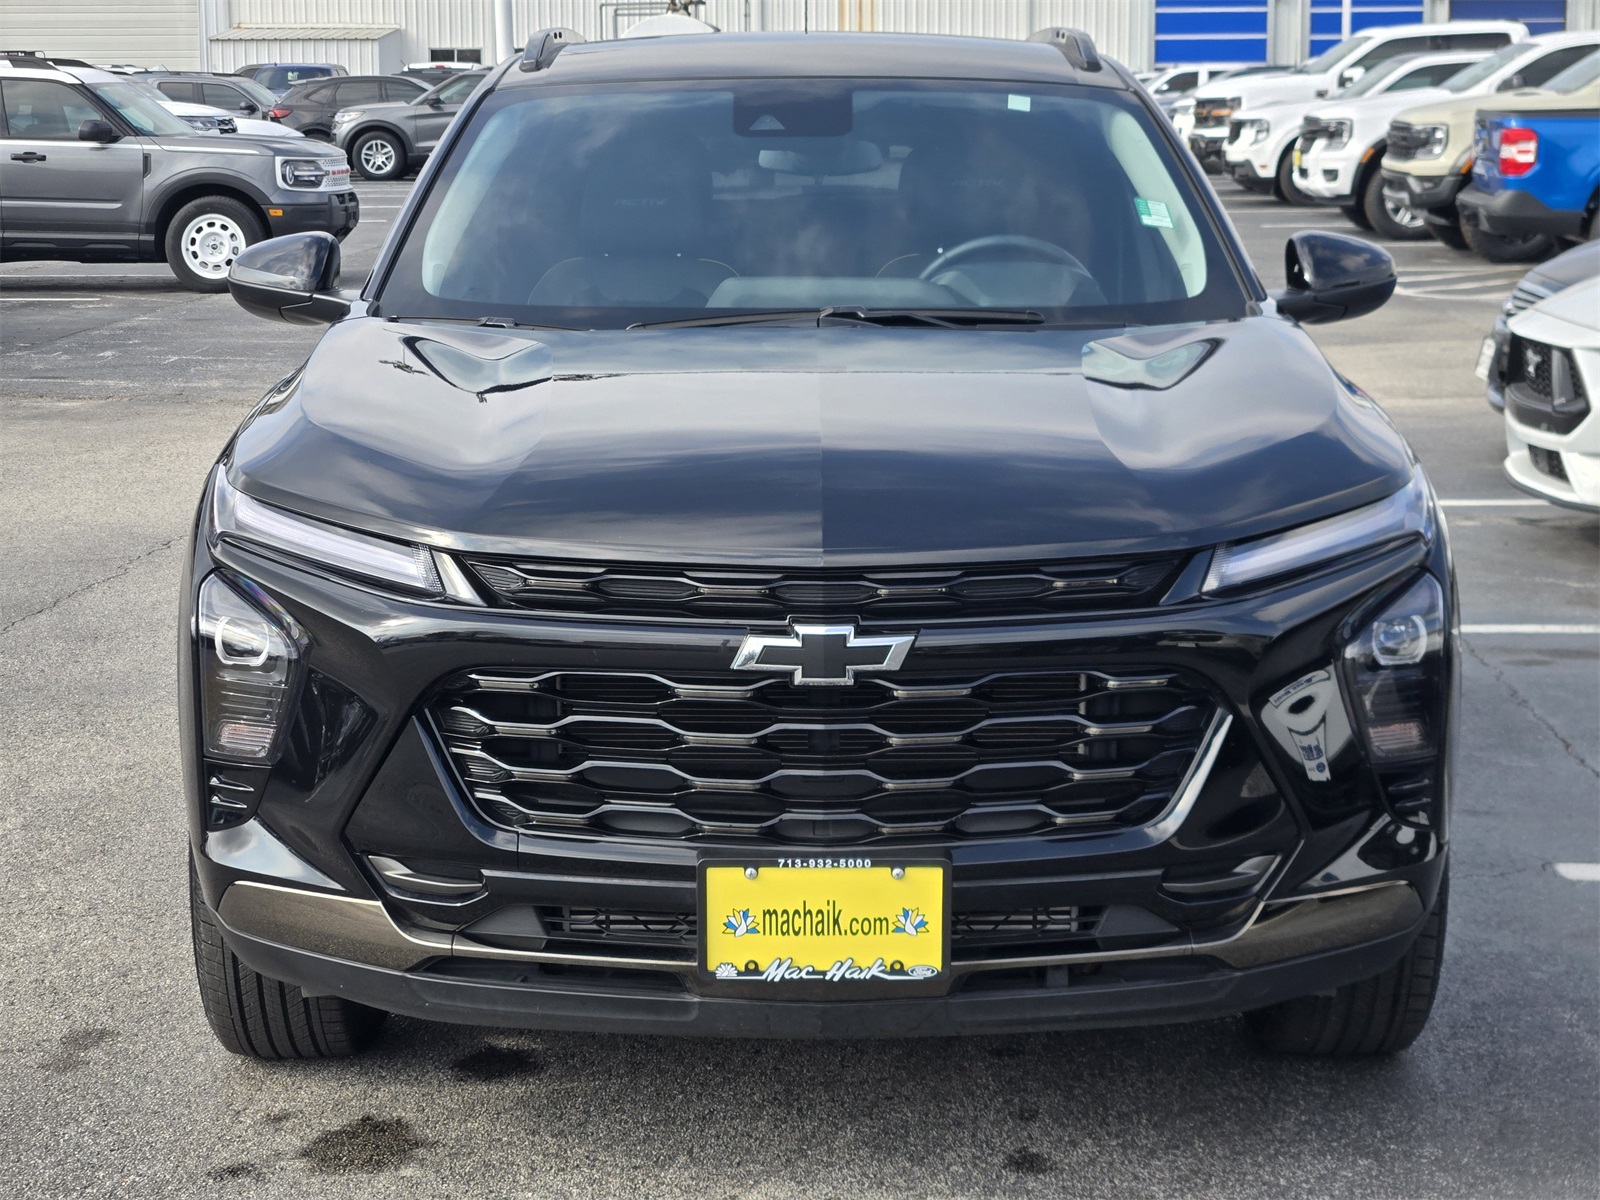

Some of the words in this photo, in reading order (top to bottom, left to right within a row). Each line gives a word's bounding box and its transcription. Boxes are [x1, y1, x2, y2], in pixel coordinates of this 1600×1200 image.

[777, 858, 872, 869] 713-932-5000
[762, 899, 890, 937] machaik.com
[761, 957, 824, 982] Mac
[824, 957, 890, 982] Haik
